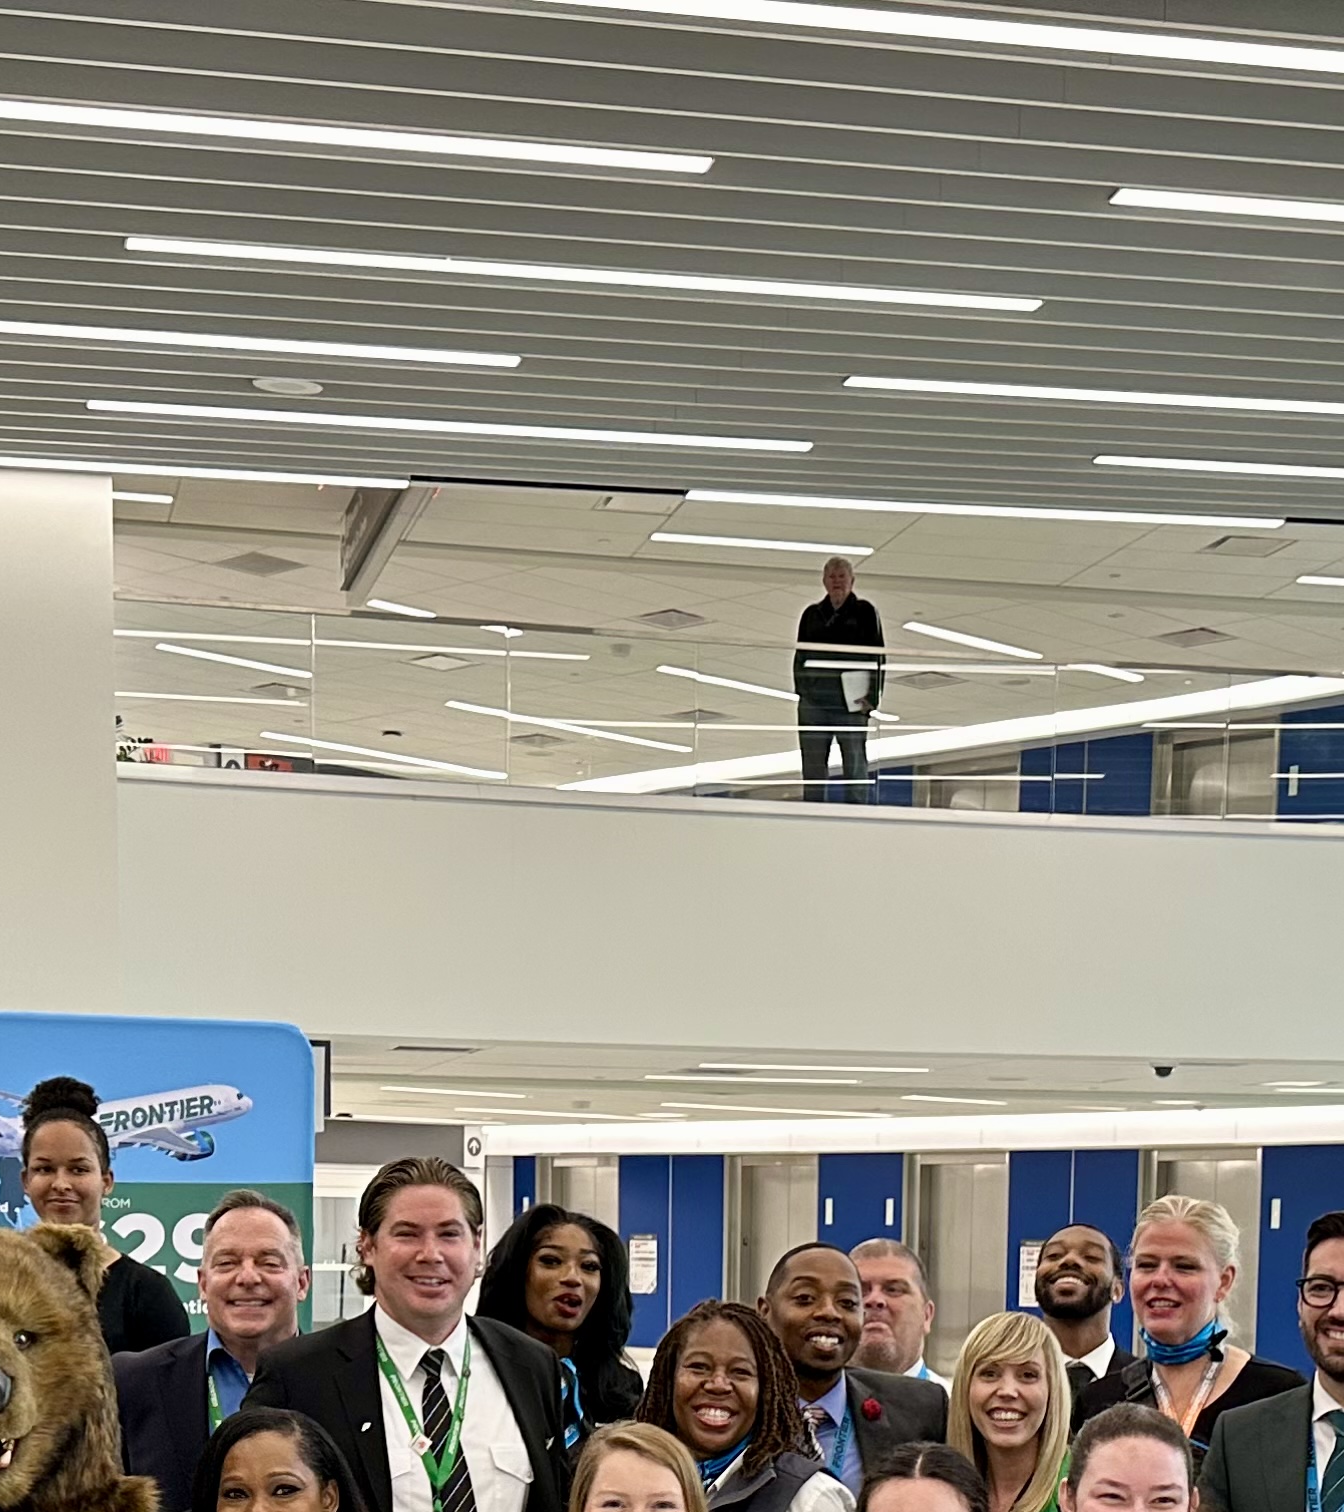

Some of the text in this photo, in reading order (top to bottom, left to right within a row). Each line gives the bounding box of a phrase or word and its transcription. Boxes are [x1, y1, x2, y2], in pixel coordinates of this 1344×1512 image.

[99, 1095, 214, 1132] FRONTIER
[101, 1197, 131, 1208] ROM
[99, 1212, 210, 1284] 29
